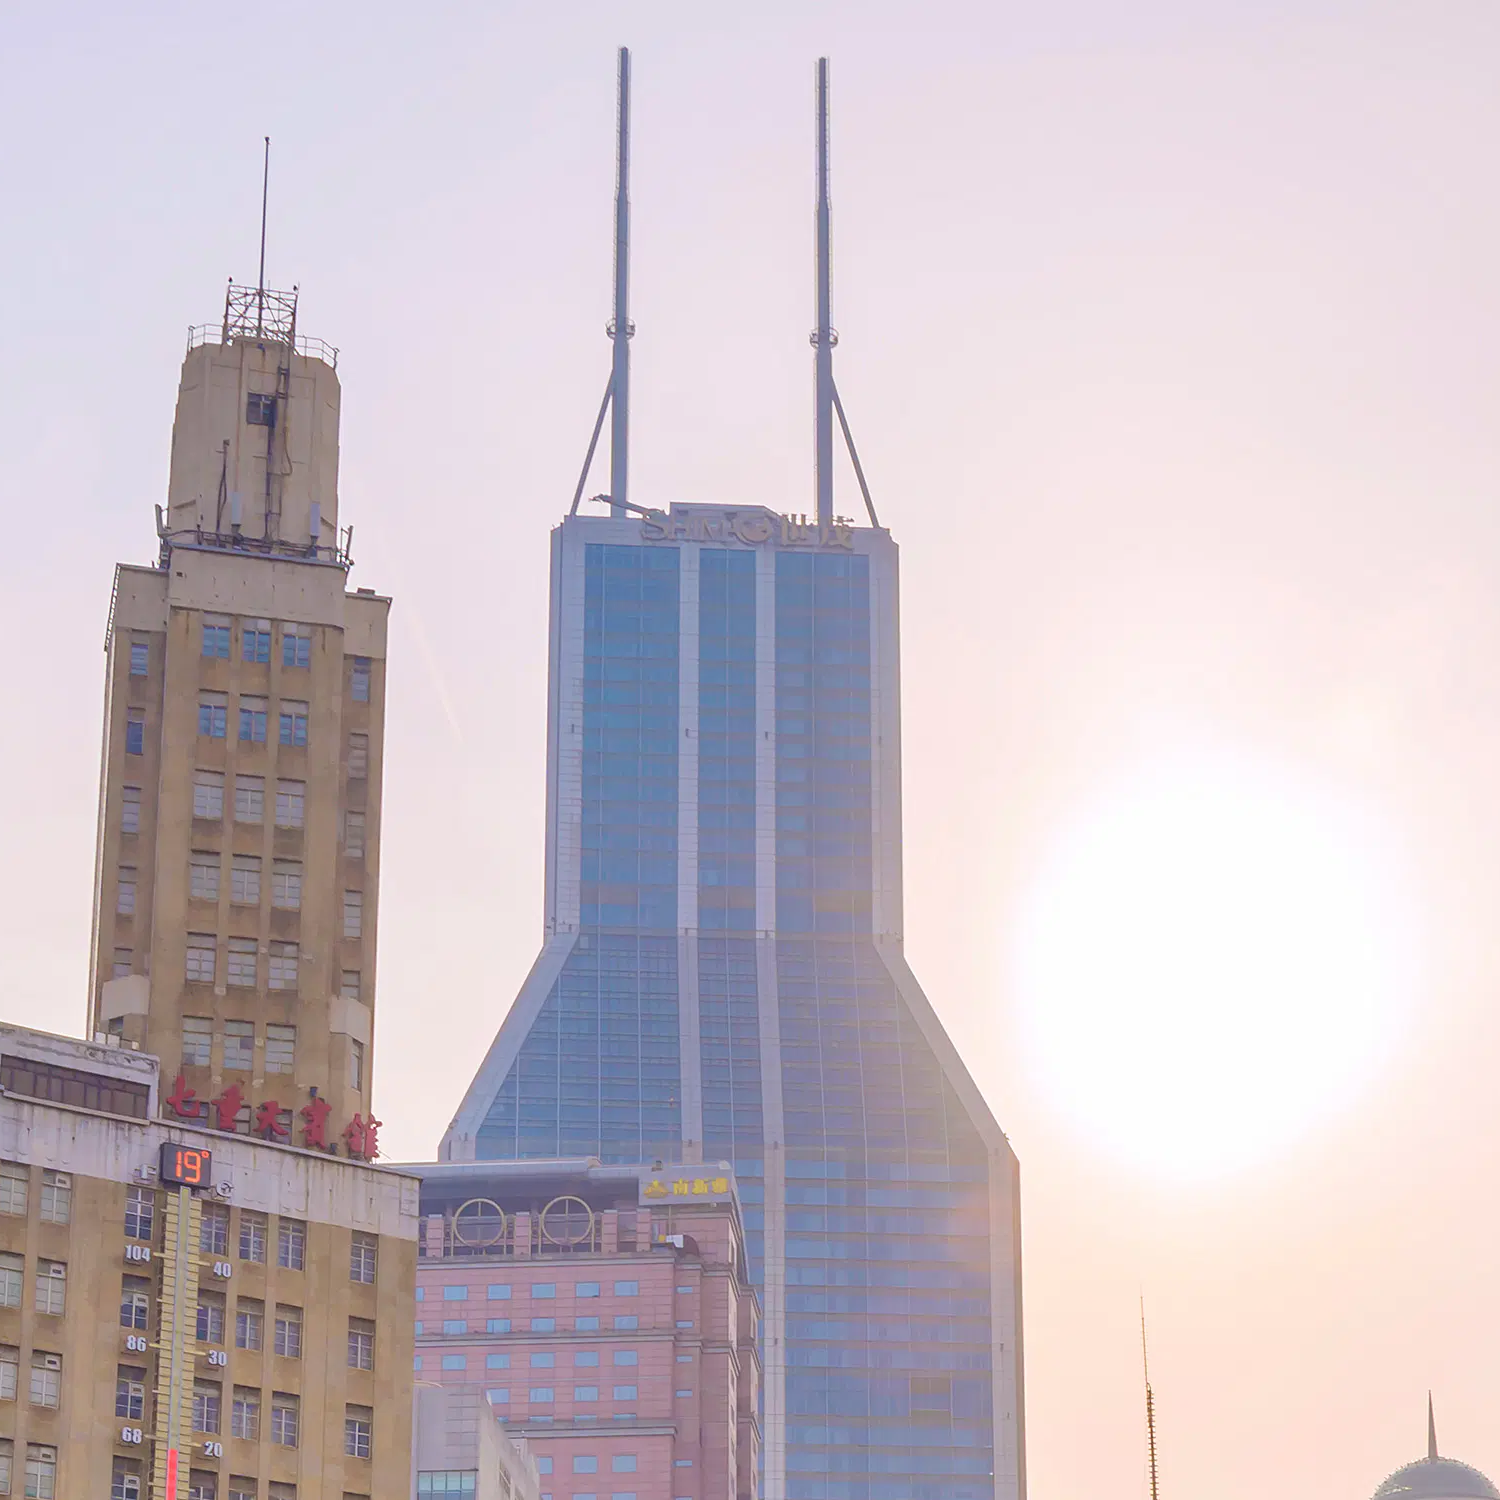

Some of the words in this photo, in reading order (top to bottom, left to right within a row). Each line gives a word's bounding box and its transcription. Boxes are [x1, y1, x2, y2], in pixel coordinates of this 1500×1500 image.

[125, 1245, 151, 1262] 104
[213, 1262, 232, 1278] 40
[127, 1335, 147, 1352] 86
[207, 1349, 228, 1367] 30
[121, 1427, 143, 1444] 68
[203, 1441, 223, 1458] 20
